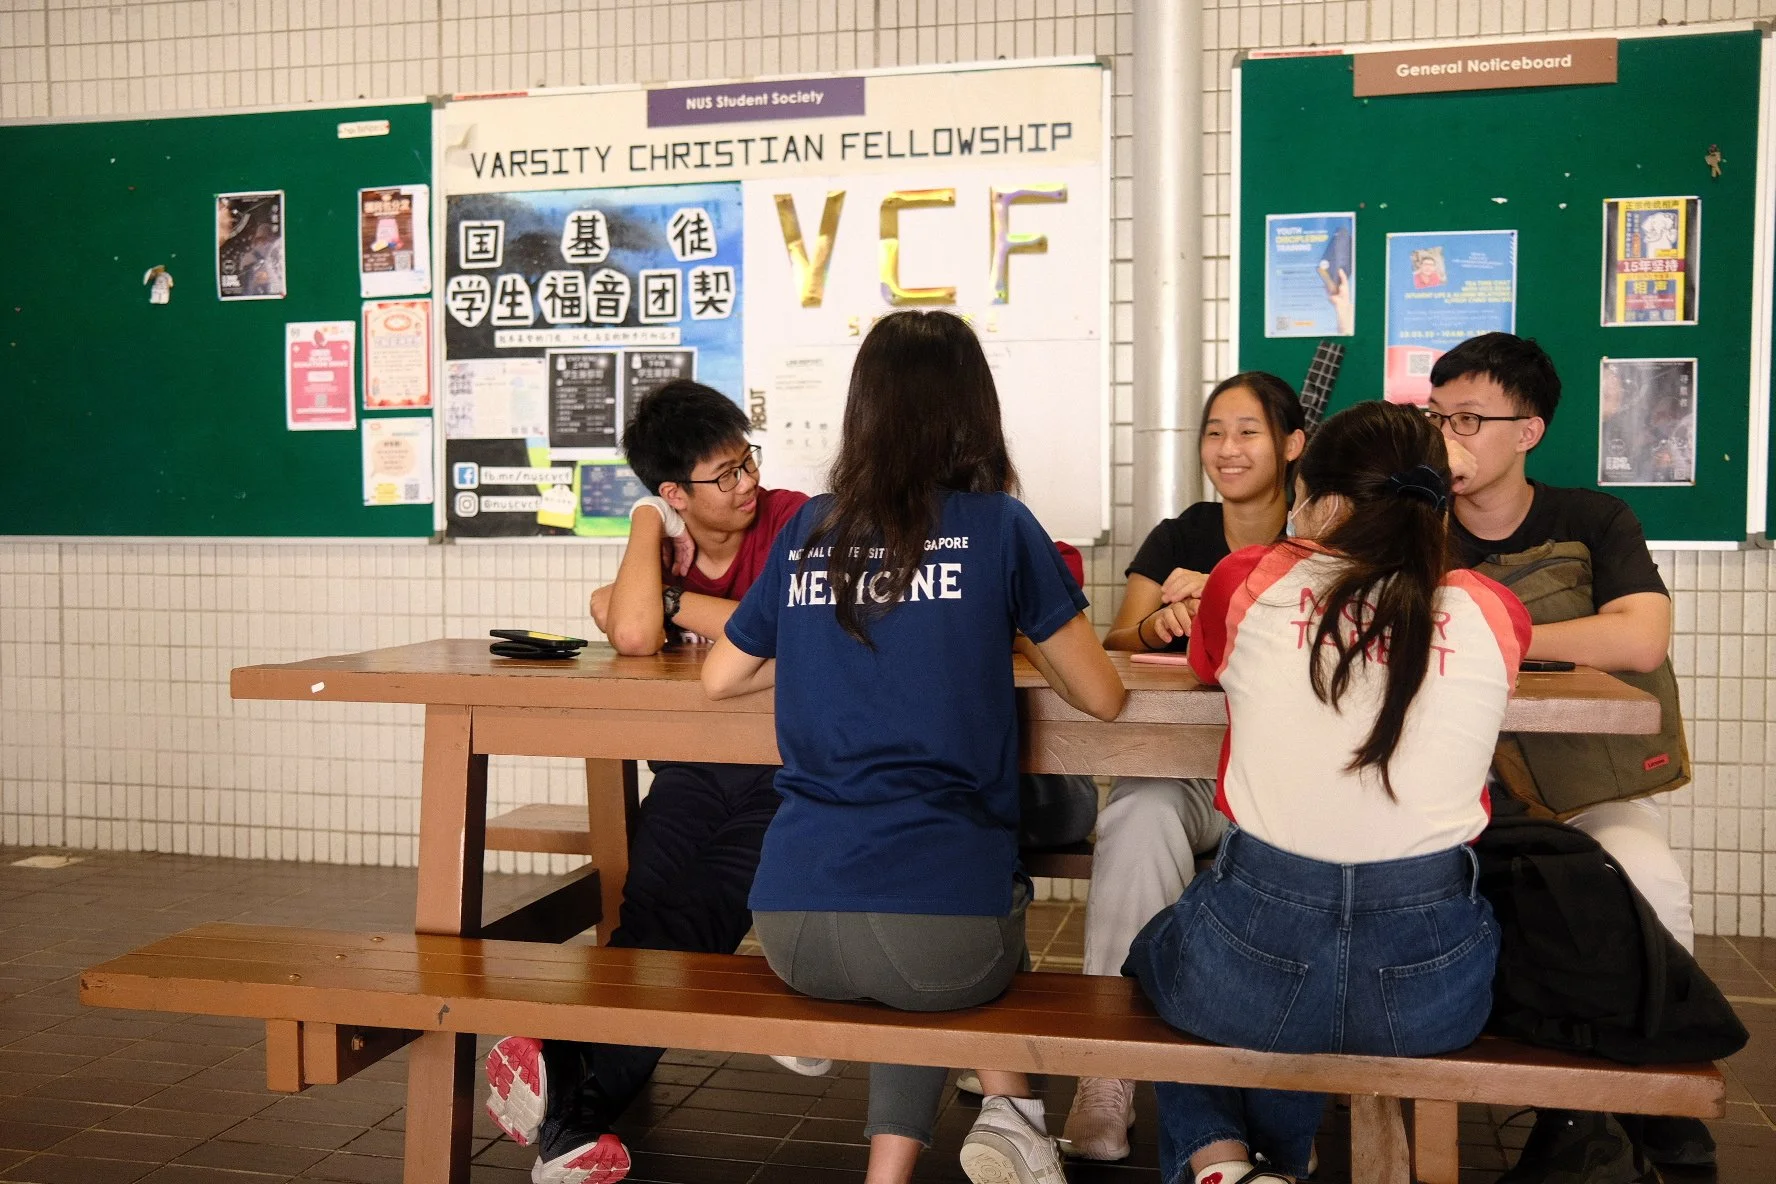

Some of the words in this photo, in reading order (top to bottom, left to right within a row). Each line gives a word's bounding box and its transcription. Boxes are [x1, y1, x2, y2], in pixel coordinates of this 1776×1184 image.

[1396, 60, 1463, 77] General
[1467, 54, 1573, 73] Noticeboard
[686, 97, 713, 110] NUS
[716, 93, 768, 108] Student
[771, 90, 824, 105] Society
[470, 145, 612, 179] VARSITY
[629, 134, 823, 172] CHRISTIAN
[841, 122, 1072, 160] FELLOWSHIP
[1623, 259, 1678, 273] 15年坚持
[750, 387, 768, 433] ABOUT
